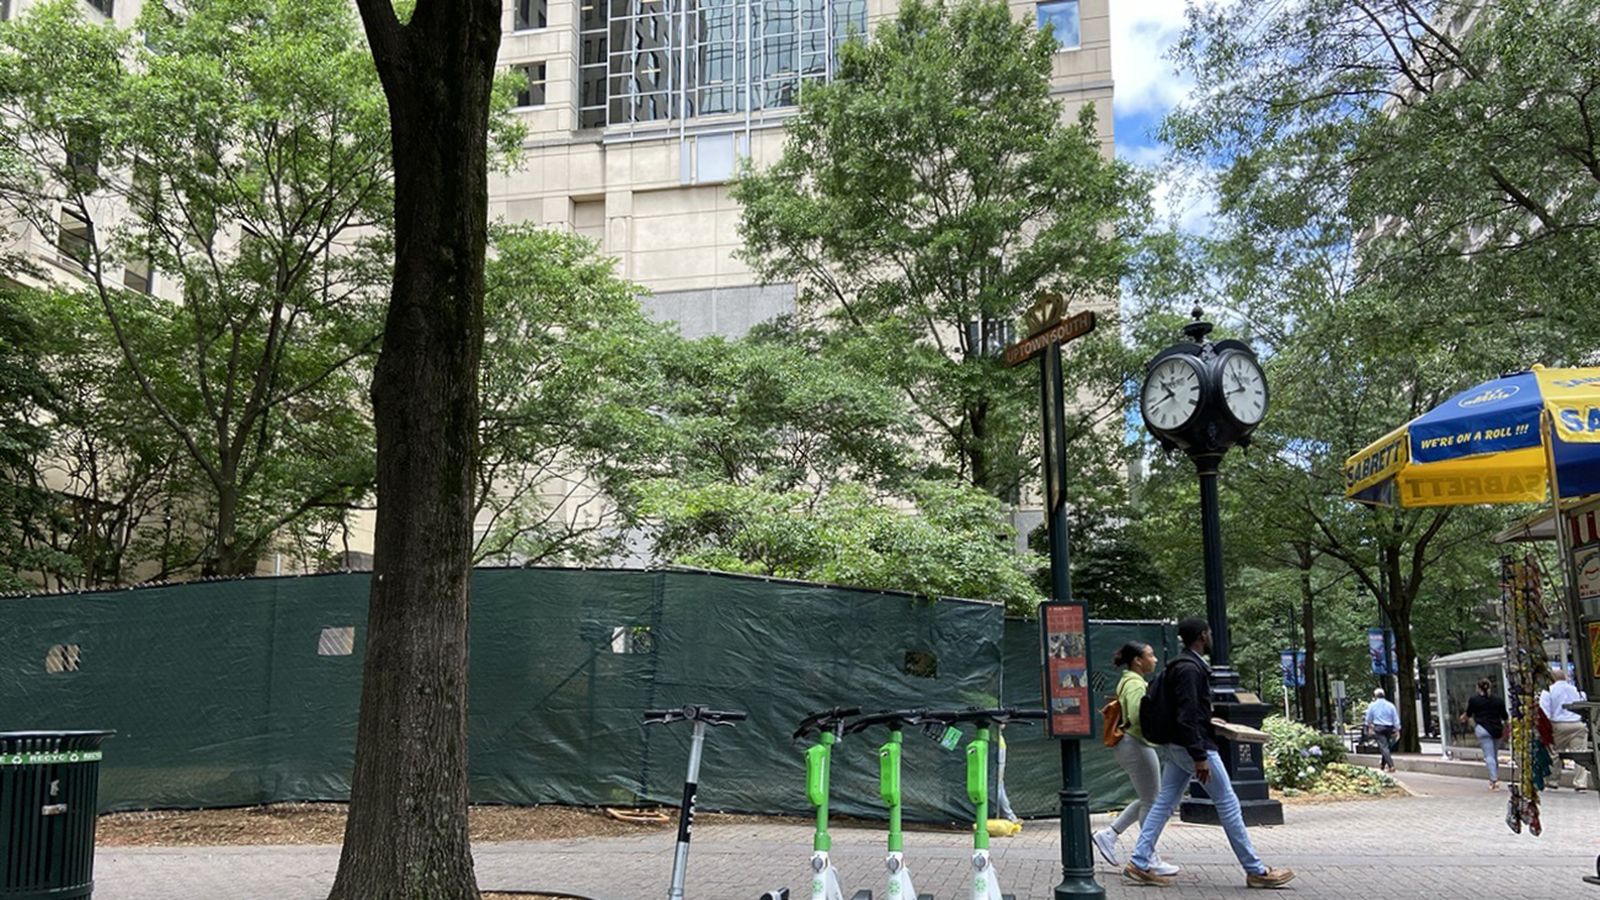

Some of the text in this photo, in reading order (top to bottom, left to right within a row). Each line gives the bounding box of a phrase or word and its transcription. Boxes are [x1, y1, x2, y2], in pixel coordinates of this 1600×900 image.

[1007, 314, 1088, 362] UPTOWN SOUTH
[1421, 436, 1454, 449] WE'RE
[1456, 432, 1472, 444] ON
[1474, 431, 1482, 440] A
[1485, 427, 1512, 440] ROLL
[1347, 439, 1402, 488] SABRETT
